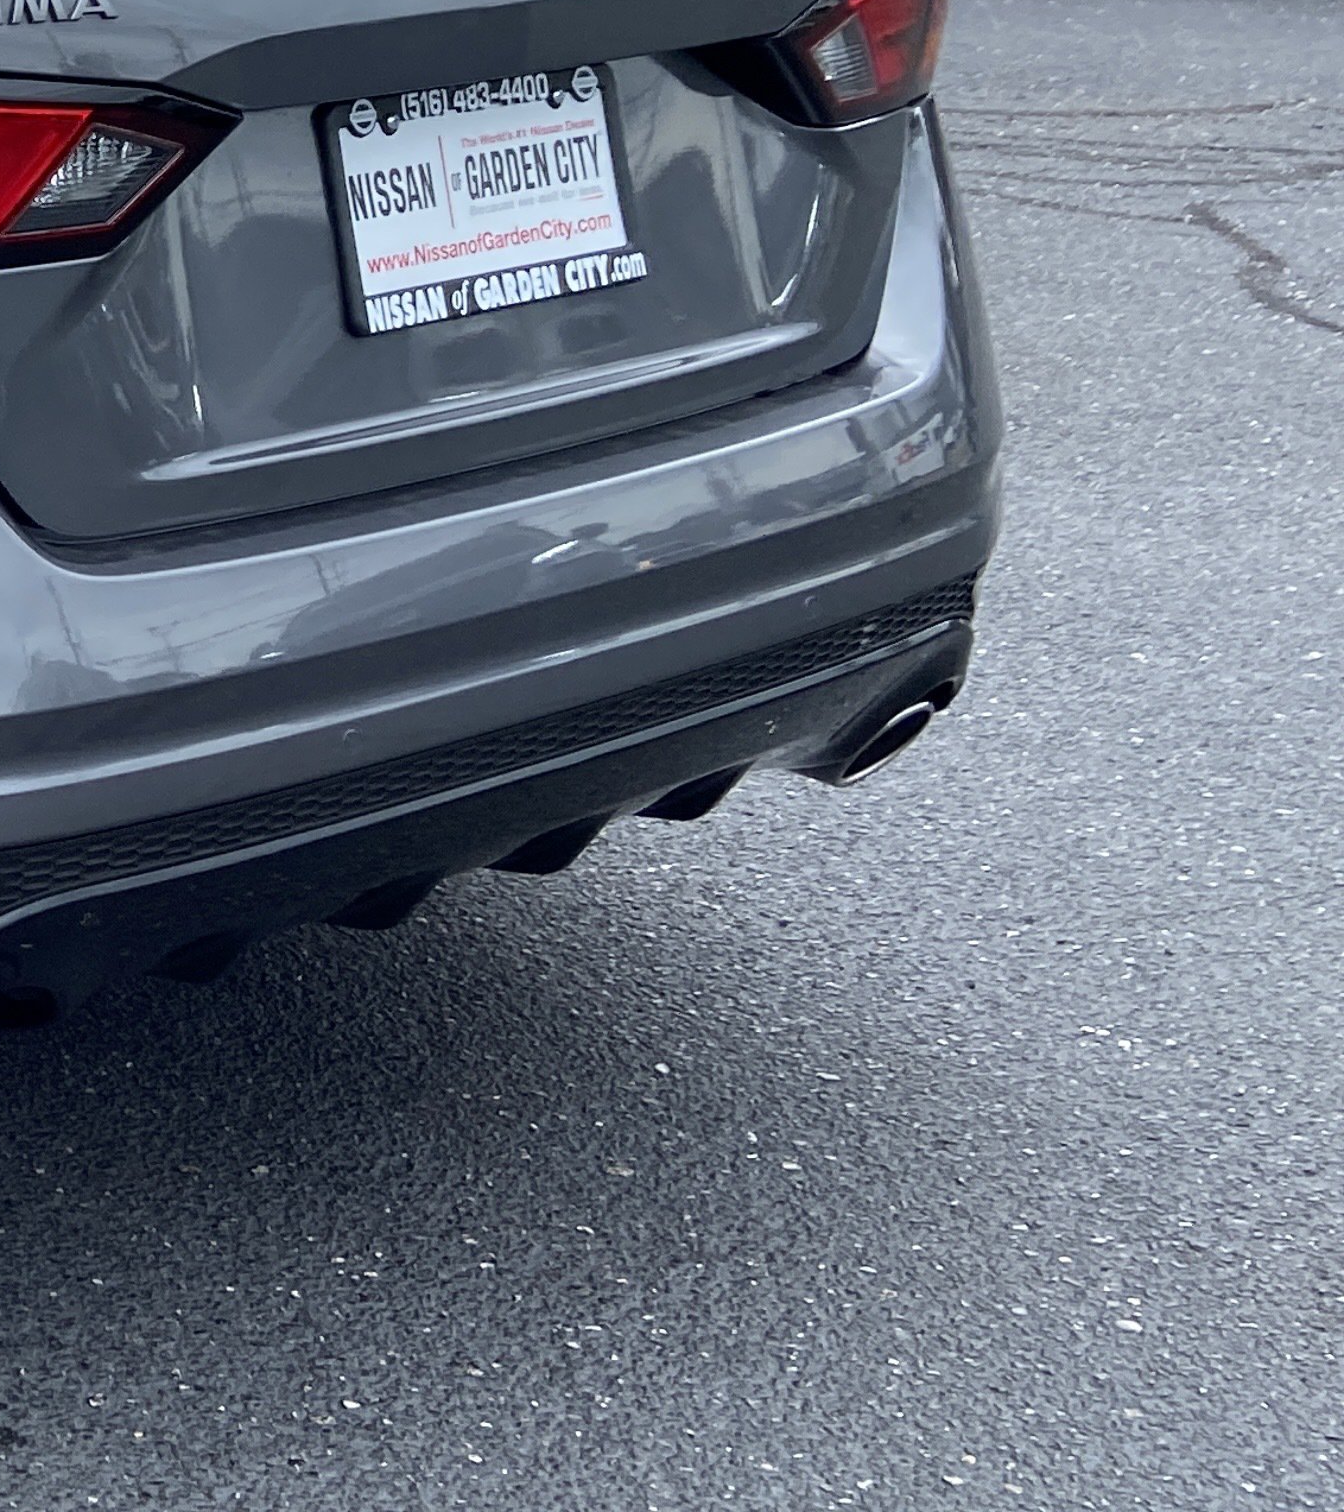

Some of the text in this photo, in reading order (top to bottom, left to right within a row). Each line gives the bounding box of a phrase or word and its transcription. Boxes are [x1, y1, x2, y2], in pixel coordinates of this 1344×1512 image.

[400, 72, 550, 120] (516) 483-4400
[348, 162, 437, 222] NISSAN
[465, 142, 551, 200] GARDEN
[553, 134, 601, 184] CITY
[366, 213, 613, 274] www.NissanofGardenCity.com
[365, 286, 448, 333] NISSAN
[451, 279, 469, 316] of
[473, 264, 561, 310] GARDEN
